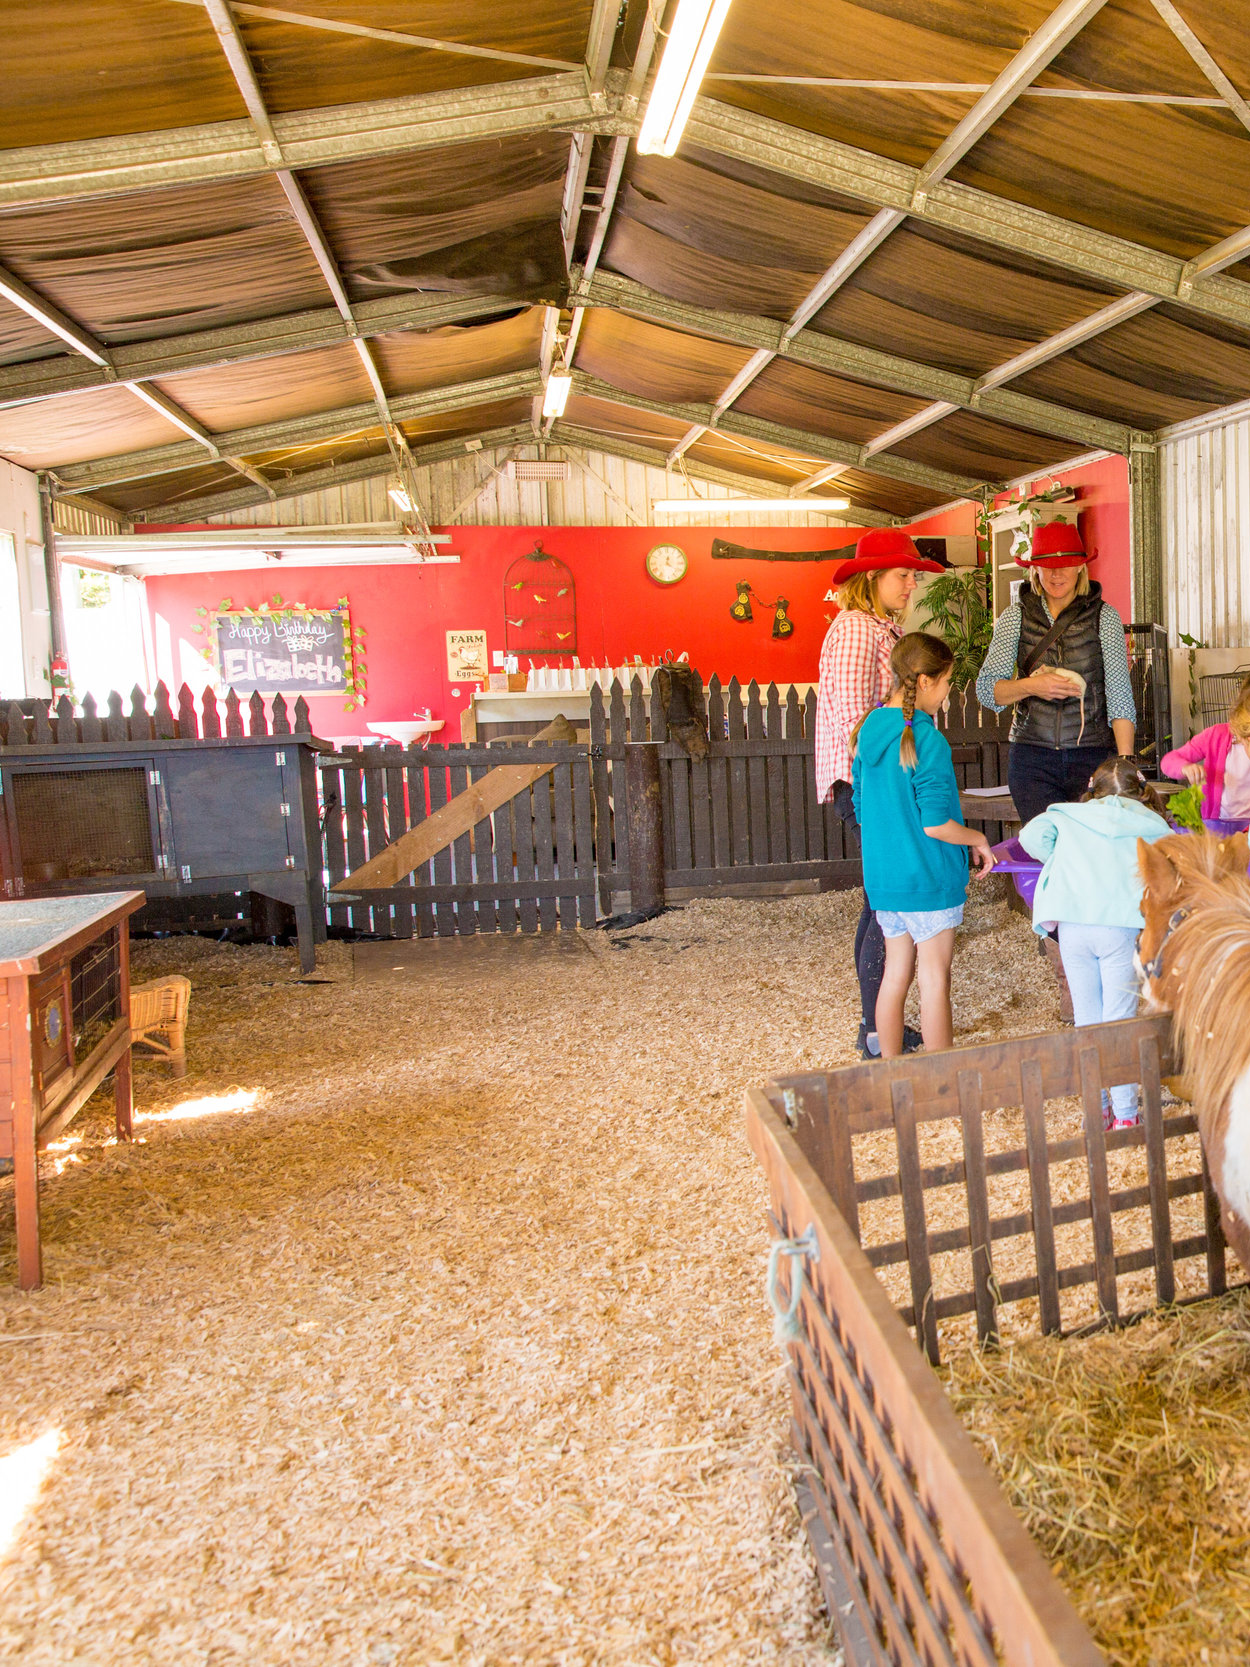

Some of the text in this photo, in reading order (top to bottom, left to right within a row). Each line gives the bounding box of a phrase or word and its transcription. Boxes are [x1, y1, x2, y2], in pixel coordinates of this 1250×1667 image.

[229, 621, 334, 645] Happy Birthday
[451, 635, 484, 643] FARM
[223, 648, 342, 685] Elizabeth
[456, 670, 475, 678] Eggs
